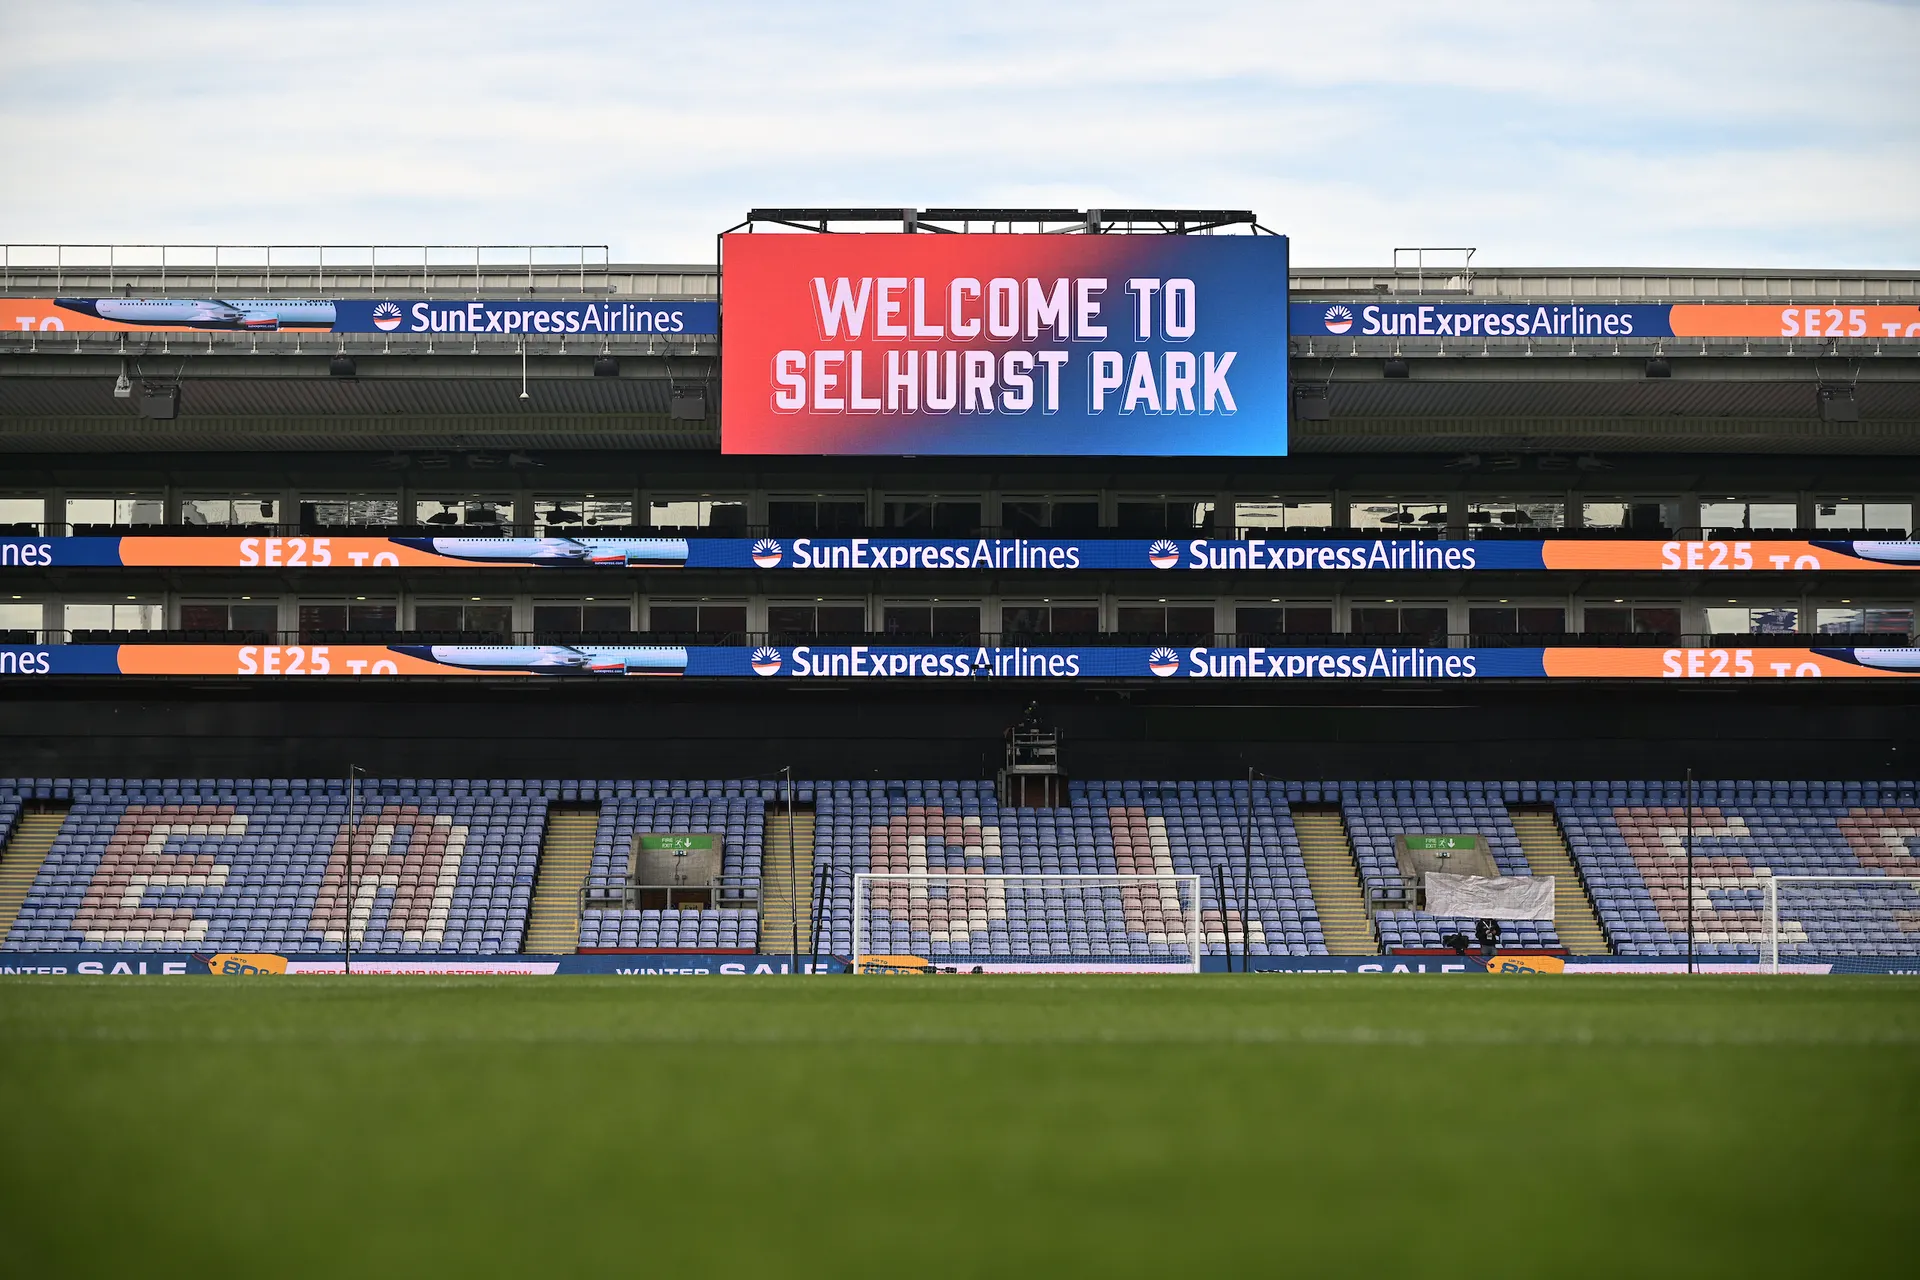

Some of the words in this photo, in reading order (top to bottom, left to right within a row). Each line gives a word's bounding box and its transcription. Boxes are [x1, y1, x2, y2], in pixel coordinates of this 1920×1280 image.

[811, 277, 1108, 342] WELCOME
[1125, 278, 1197, 342] TO
[1781, 309, 1867, 337] SE25
[1881, 322, 1920, 337] T
[771, 350, 1069, 416] SELHURST
[1087, 351, 1238, 416] PARK
[239, 538, 332, 567] SE25
[1661, 540, 1754, 569] SE25
[237, 646, 331, 675] SE25
[1662, 649, 1755, 678] SE25
